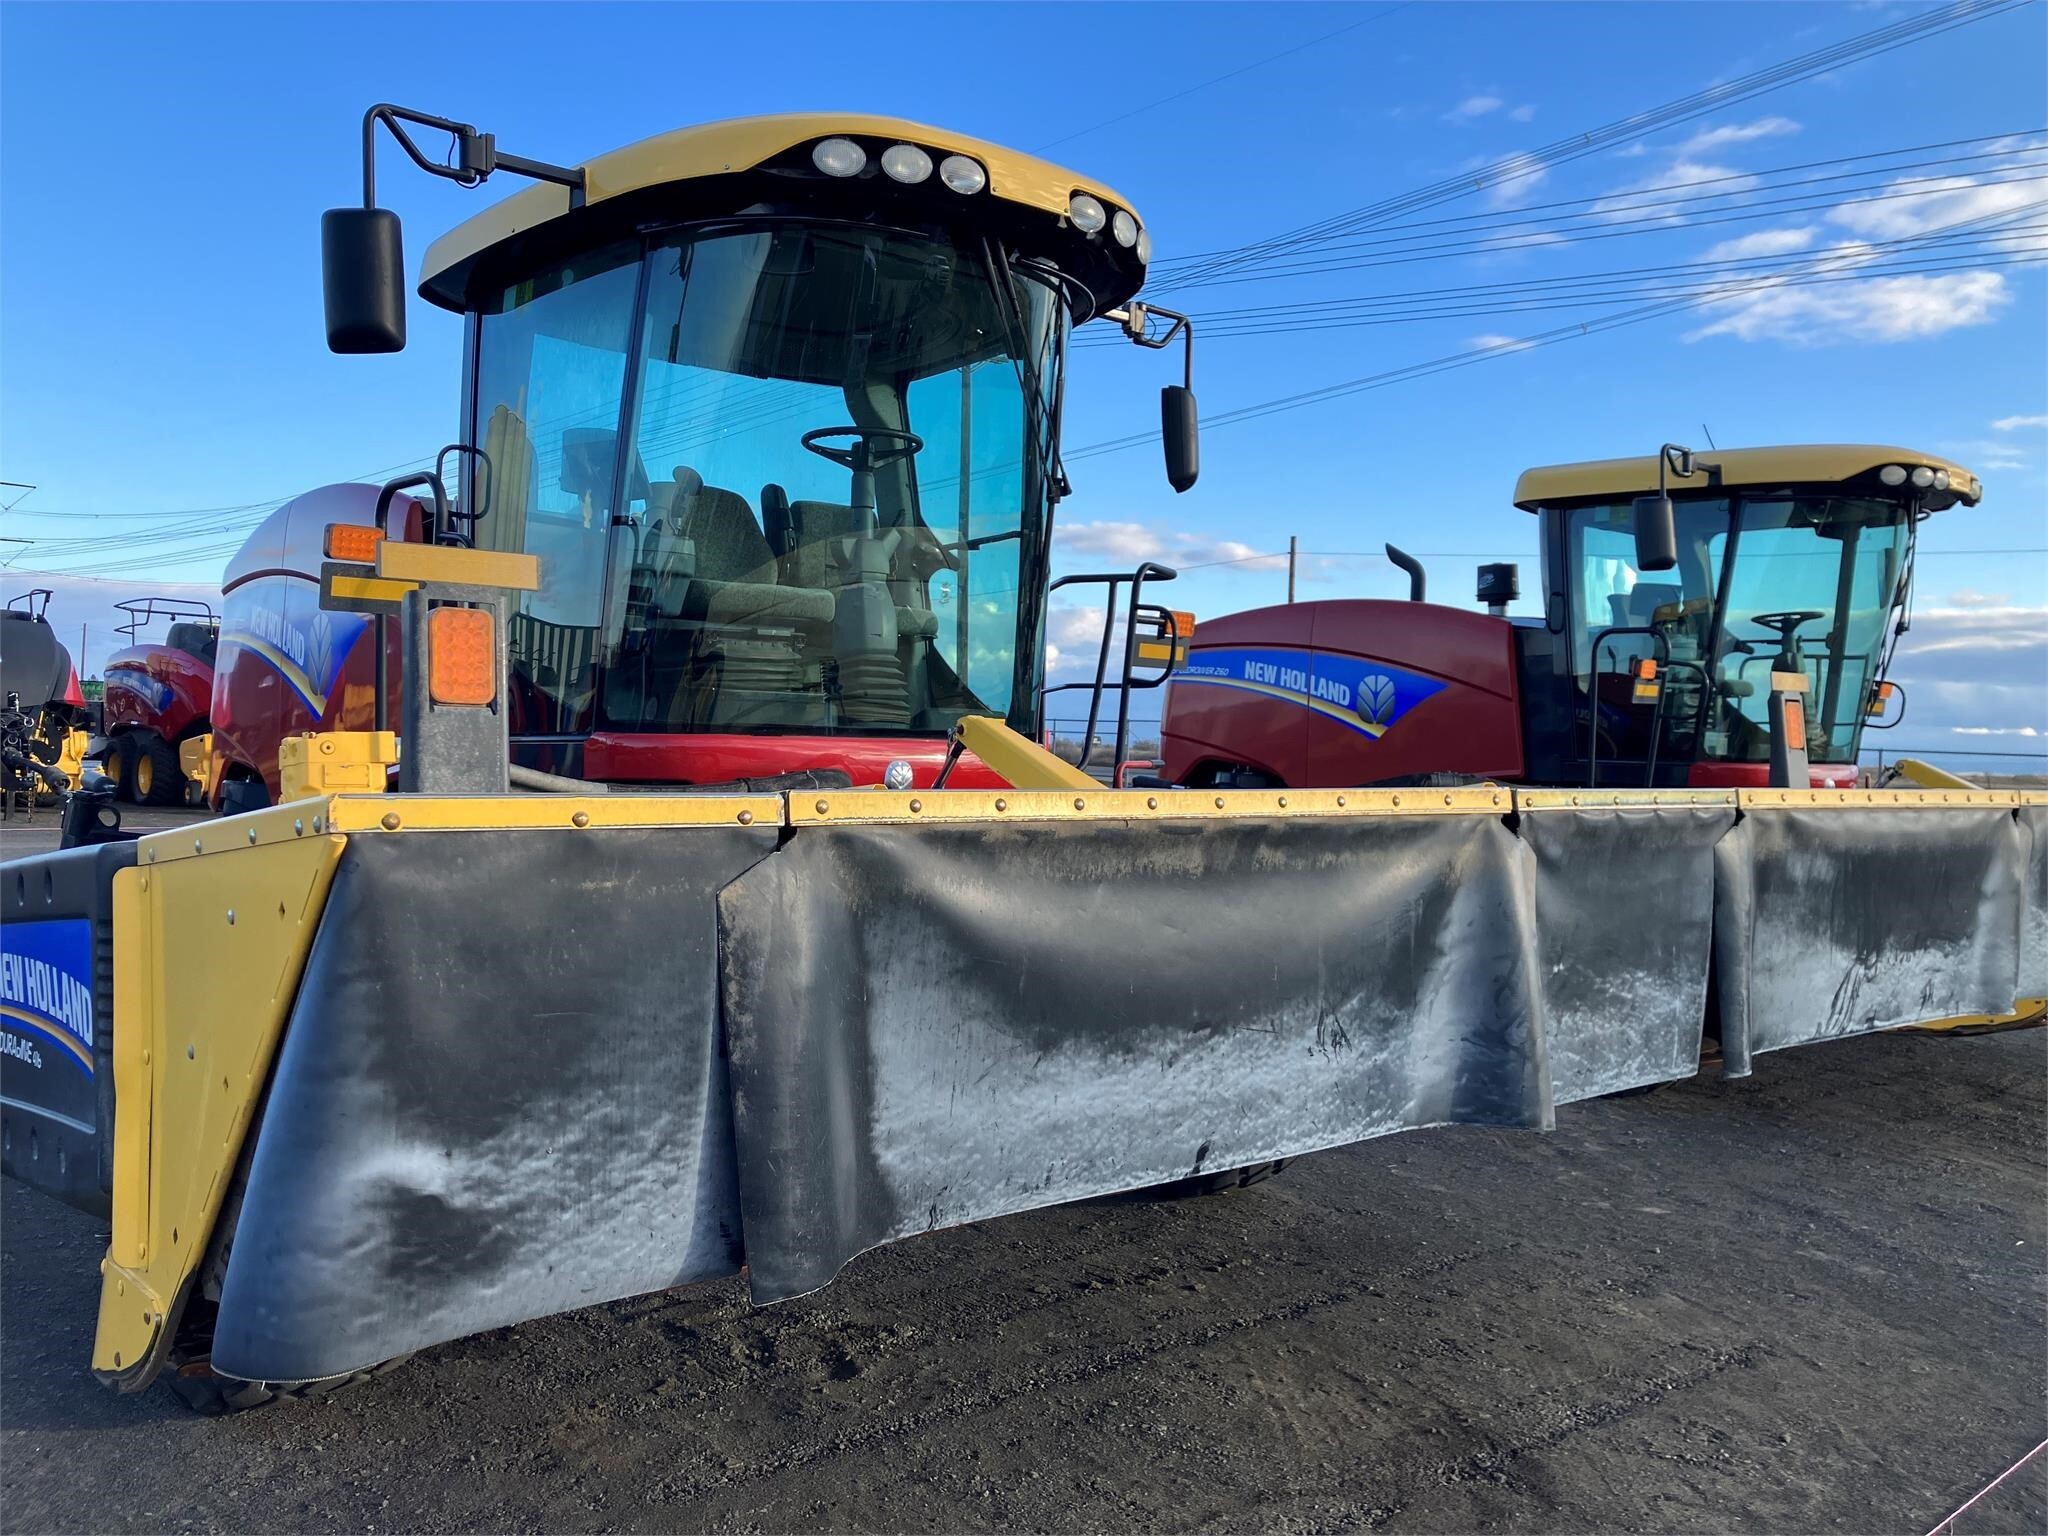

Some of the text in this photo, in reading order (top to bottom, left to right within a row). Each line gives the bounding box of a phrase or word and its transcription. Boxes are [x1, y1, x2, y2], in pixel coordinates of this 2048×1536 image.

[267, 610, 304, 666] HOLLAND
[1244, 660, 1350, 706] NEW HOLLAND
[24, 957, 93, 1047] HOLLAND
